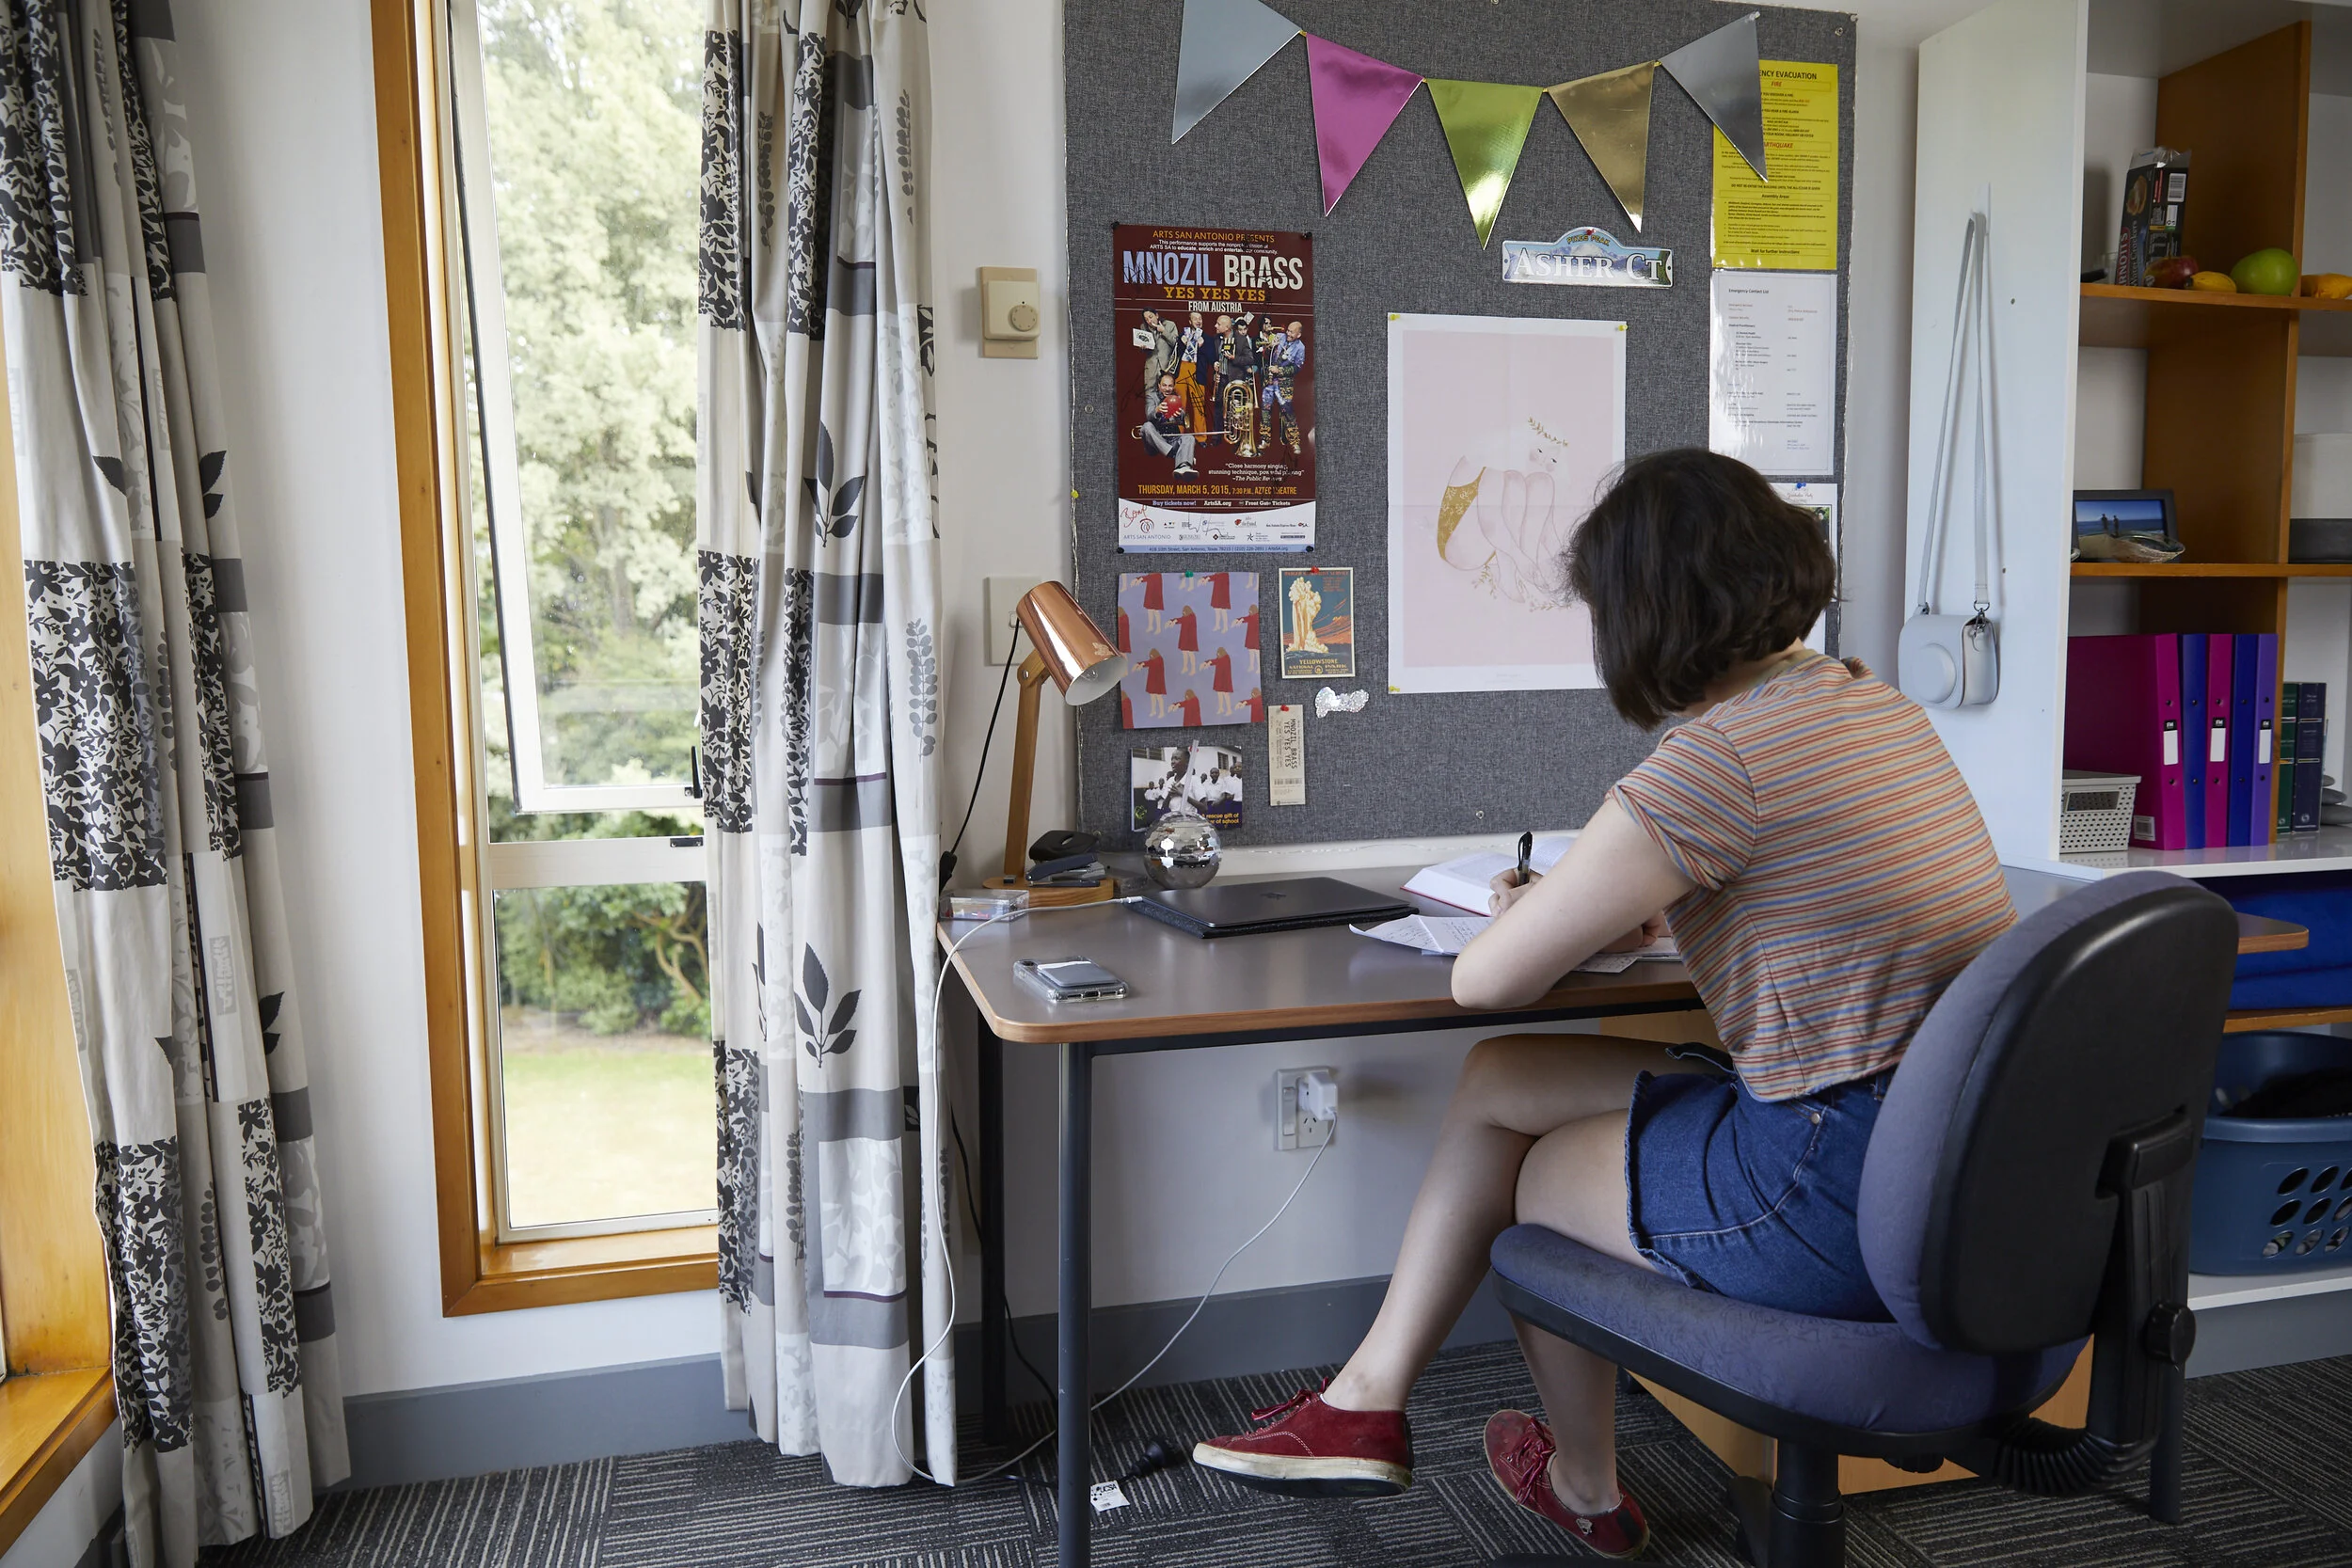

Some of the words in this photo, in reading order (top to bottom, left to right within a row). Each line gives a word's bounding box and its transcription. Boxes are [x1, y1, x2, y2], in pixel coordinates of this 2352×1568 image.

[1776, 71, 1817, 80] EVACUATION
[1152, 230, 1173, 239] ARTS
[1194, 232, 1234, 241] ANTONIO
[1590, 234, 1611, 246] PEAK
[1123, 250, 1217, 287] MNOZIL
[1224, 254, 1304, 291] BRASS
[1163, 287, 1195, 299] YES
[1200, 287, 1231, 300] YES
[1235, 289, 1265, 302] YES
[1188, 301, 1211, 312] FROM
[1211, 302, 1243, 313] AUSTRIA
[1138, 484, 1175, 495] THURSDAY,
[1177, 484, 1201, 495] MARCH
[1202, 484, 1210, 495] 5,
[1211, 485, 1231, 495] 2015,
